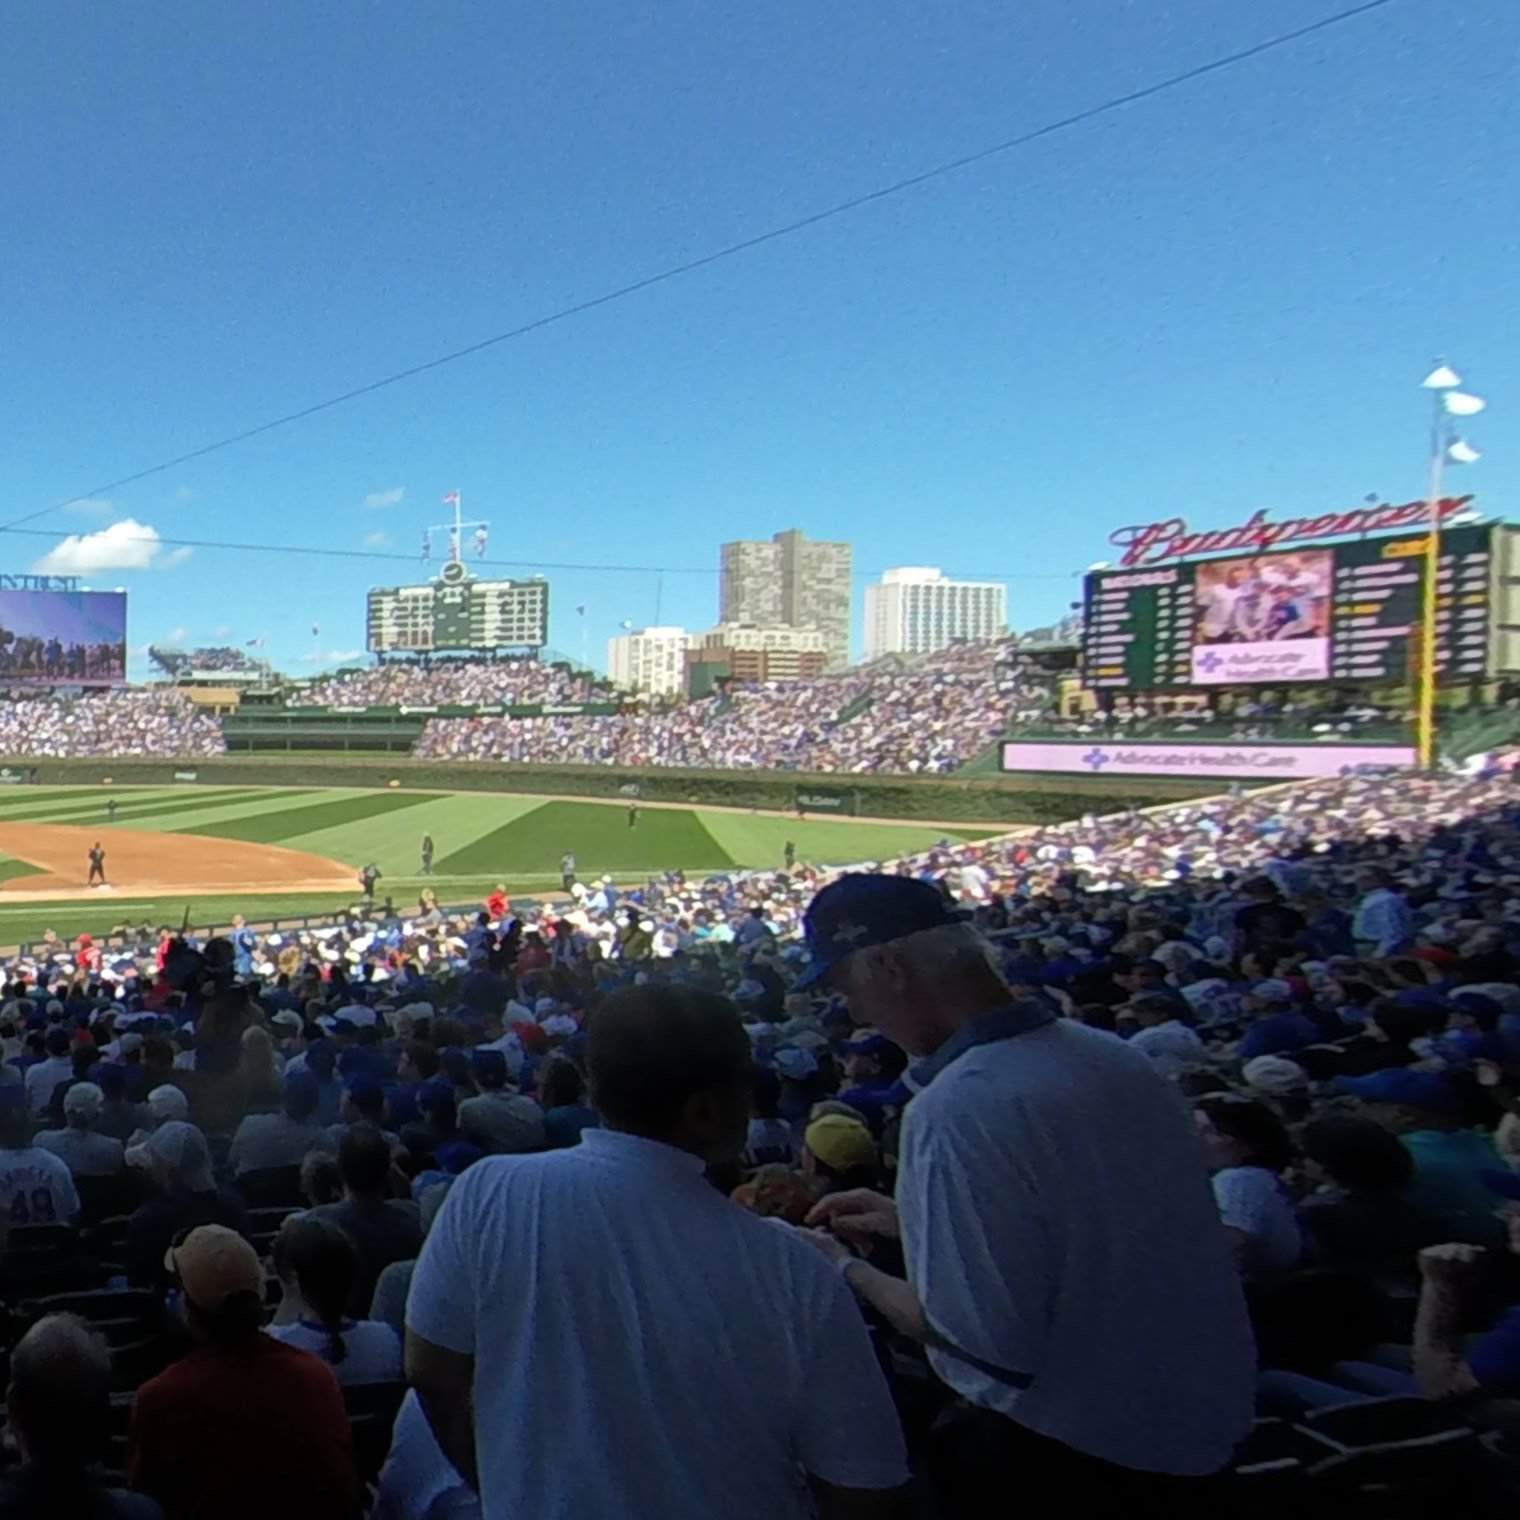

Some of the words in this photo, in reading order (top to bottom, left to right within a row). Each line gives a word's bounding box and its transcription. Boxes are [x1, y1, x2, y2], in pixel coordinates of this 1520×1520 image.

[1109, 494, 1474, 565] Budweiser
[1228, 652, 1304, 665] Advocate
[1226, 666, 1278, 677] Health
[1281, 666, 1321, 677] Care
[1113, 751, 1187, 767] Advocate
[1188, 751, 1247, 767] Health
[1250, 752, 1298, 768] Care
